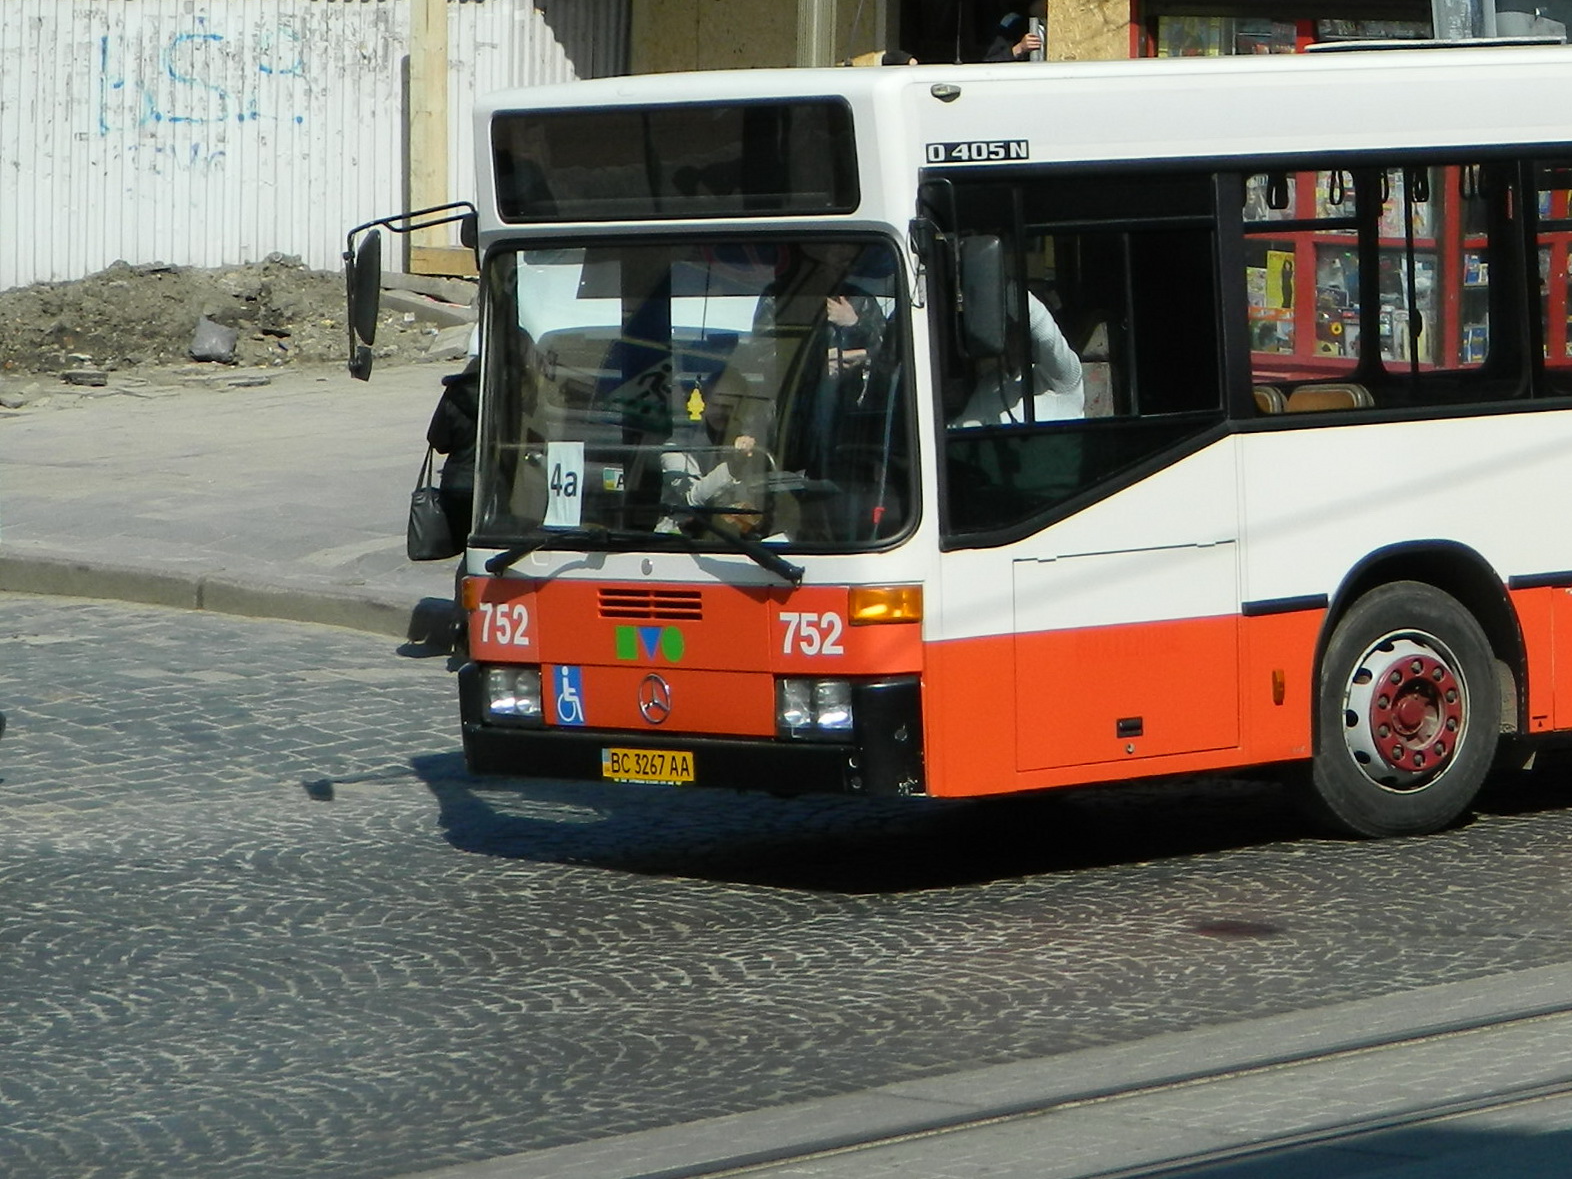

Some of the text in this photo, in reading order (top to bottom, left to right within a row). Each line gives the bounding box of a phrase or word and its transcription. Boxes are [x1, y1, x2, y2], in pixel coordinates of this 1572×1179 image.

[951, 143, 1005, 161] 405
[479, 602, 530, 645] 752
[779, 611, 844, 655] 752
[634, 753, 665, 775] 3267
